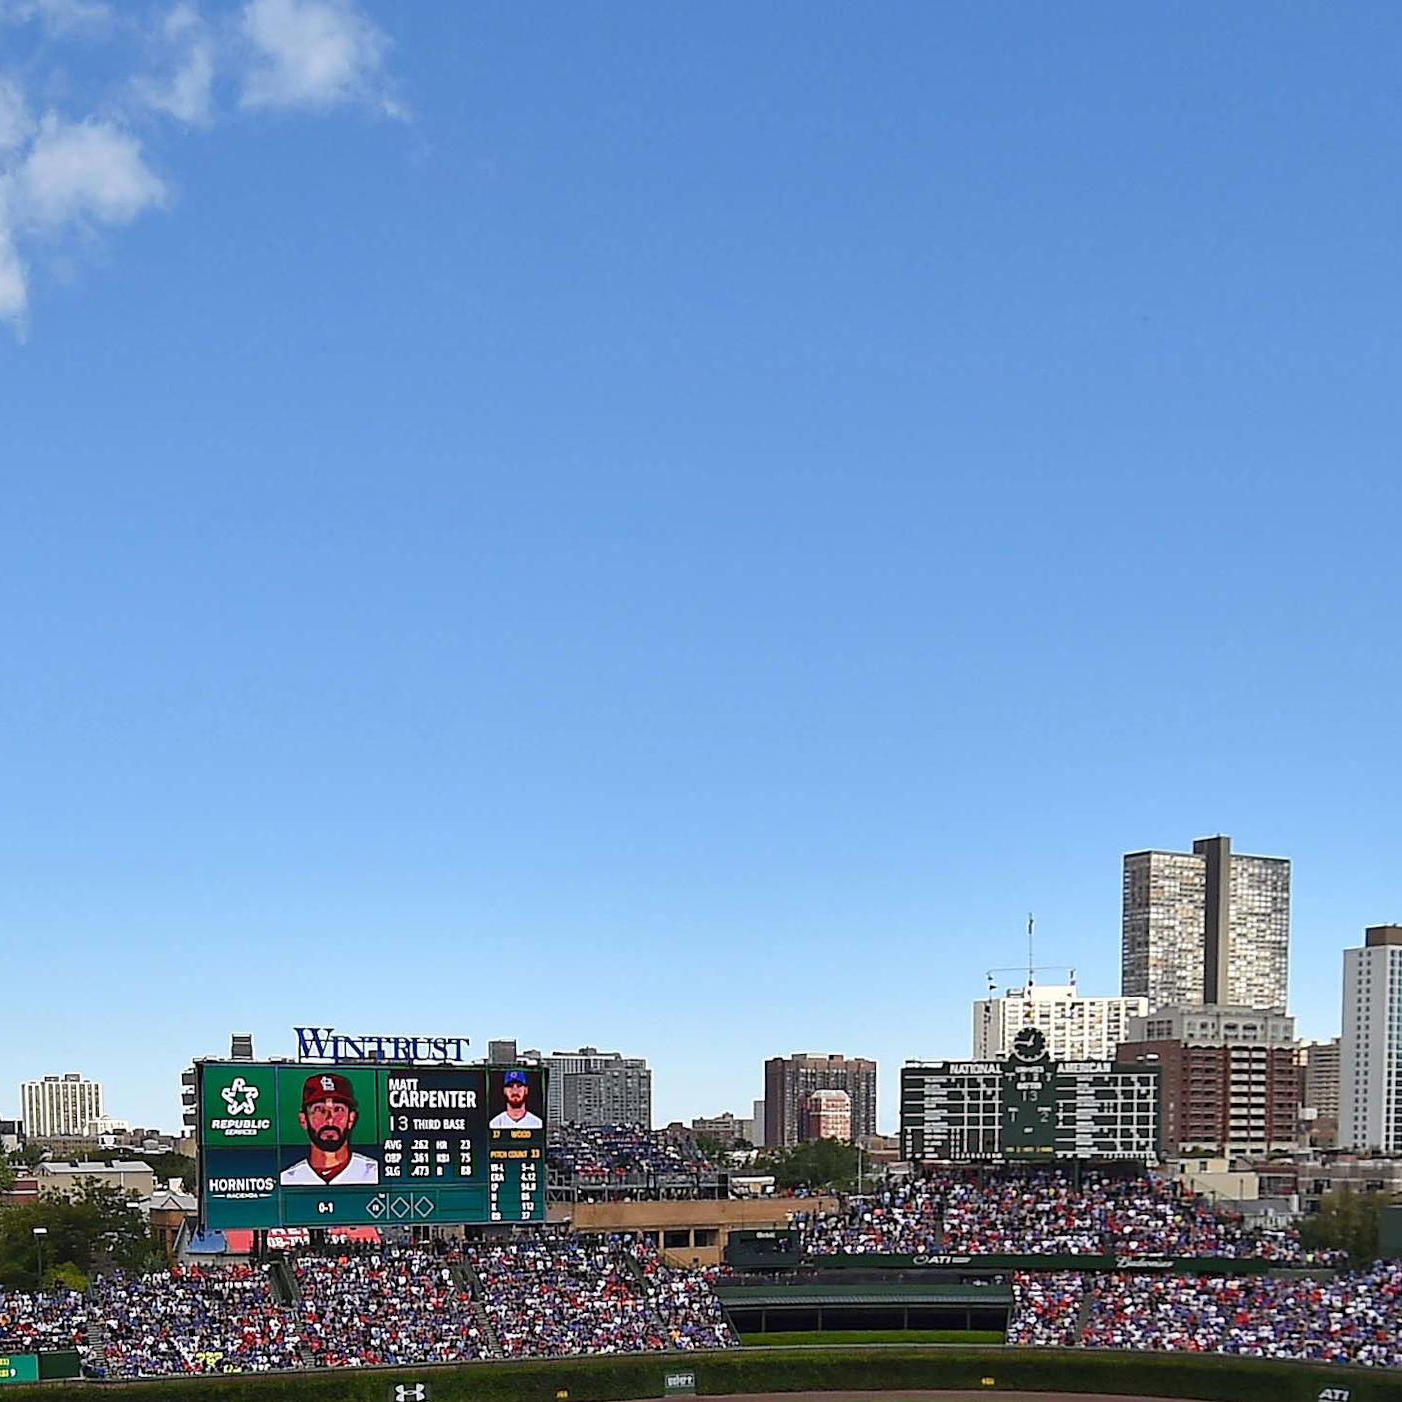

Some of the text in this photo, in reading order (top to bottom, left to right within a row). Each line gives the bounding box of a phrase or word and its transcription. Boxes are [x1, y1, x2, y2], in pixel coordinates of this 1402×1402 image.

[294, 1027, 470, 1063] WINTRUST
[950, 1063, 1003, 1075] NATIONAL
[1057, 1062, 1112, 1073] AMERICAN
[388, 1078, 418, 1091] MATT
[389, 1090, 477, 1108] CARPENTER
[211, 1119, 271, 1130] REPUBLIC
[389, 1115, 466, 1131] 13 THIRD BASE
[384, 1139, 402, 1150] AVG
[384, 1166, 401, 1177] SLG
[209, 1178, 275, 1193] HORNITOS
[927, 1256, 951, 1264] ATI
